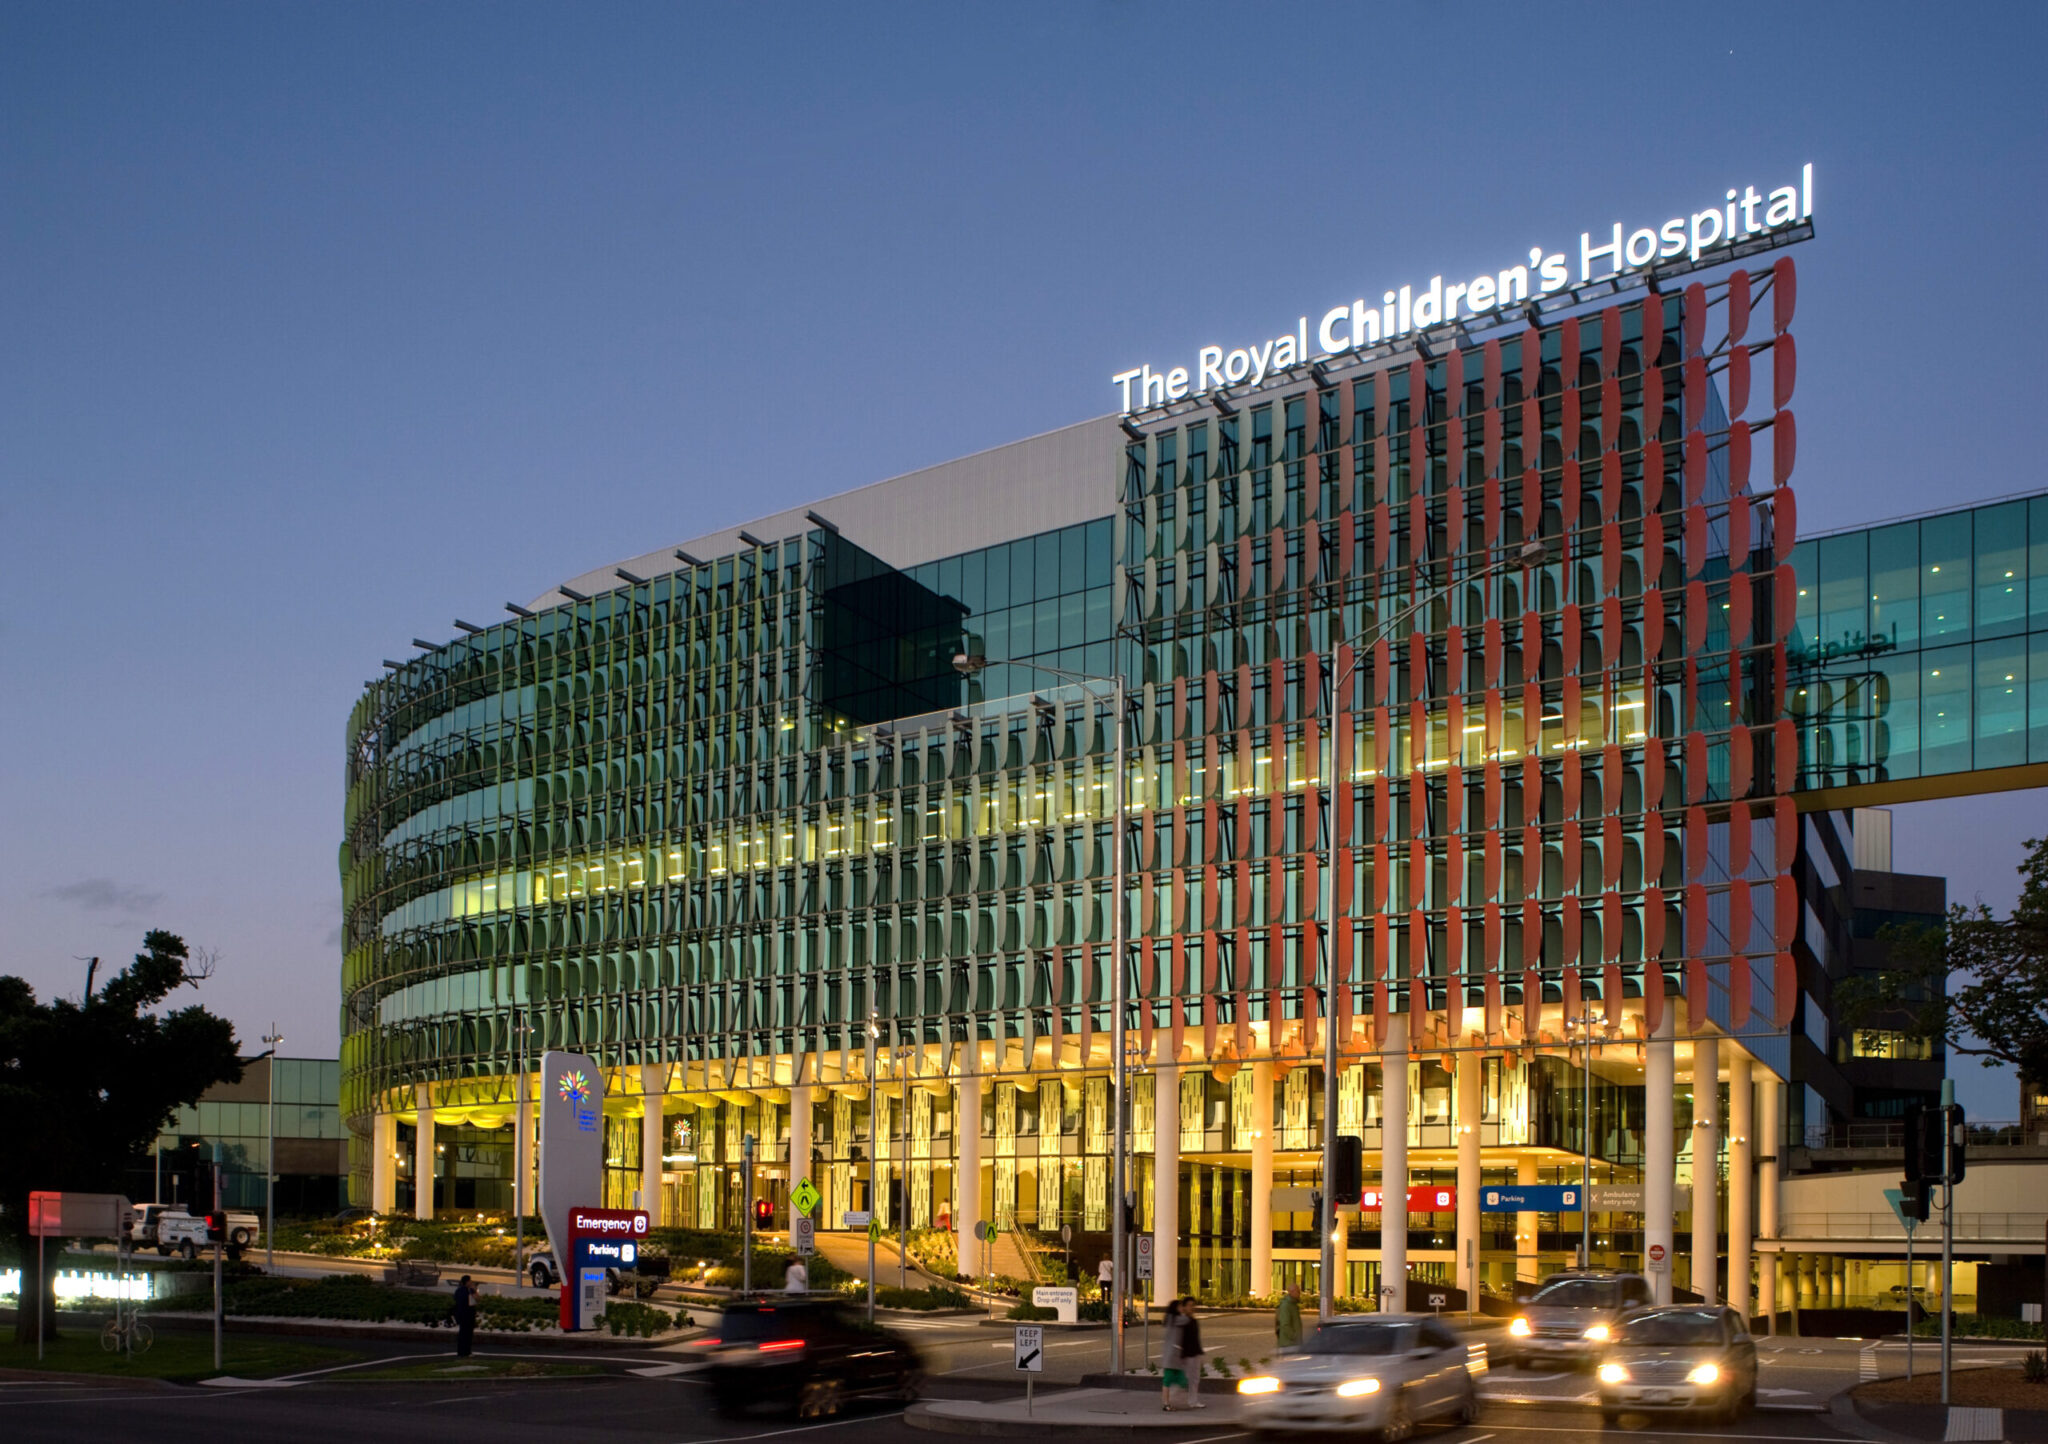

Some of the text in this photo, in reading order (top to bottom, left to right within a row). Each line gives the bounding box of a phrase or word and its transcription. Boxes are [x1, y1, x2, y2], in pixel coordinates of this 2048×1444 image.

[1112, 162, 1812, 414] The Royal Children's Hospital
[1500, 1194, 1525, 1204] Parking
[1622, 1199, 1637, 1207] only
[576, 1215, 631, 1233] Emergency
[588, 1244, 619, 1258] Parking
[1019, 1329, 1038, 1338] KEEP
[1020, 1339, 1037, 1347] LEFT
